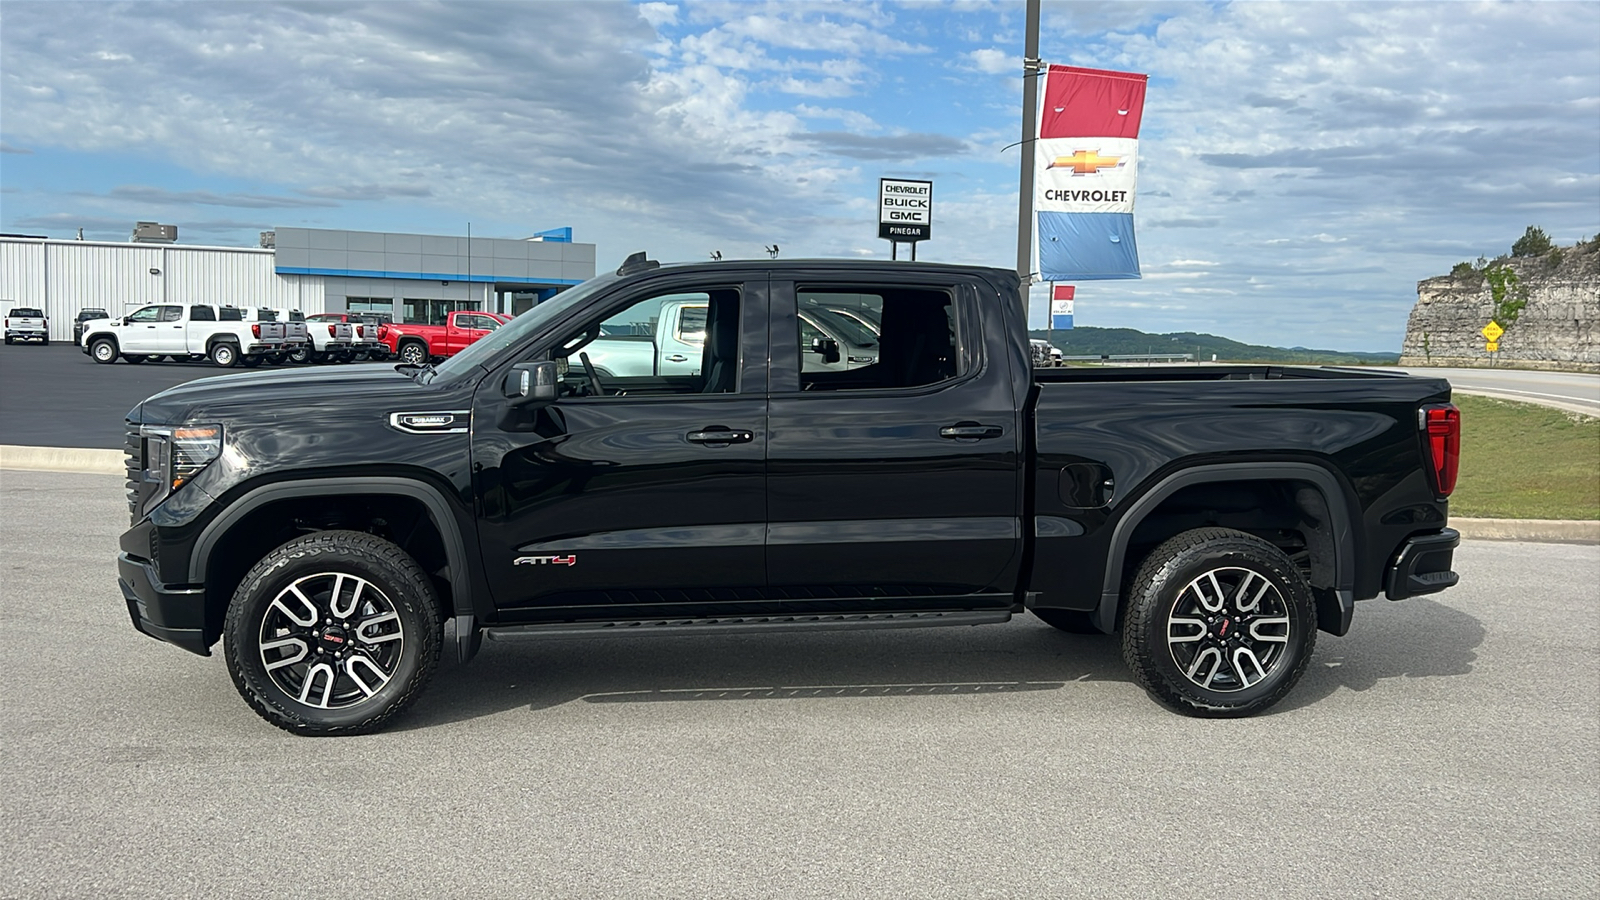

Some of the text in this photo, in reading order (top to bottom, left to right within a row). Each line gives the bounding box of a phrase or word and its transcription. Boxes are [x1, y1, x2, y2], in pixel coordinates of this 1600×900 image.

[885, 185, 928, 195] CHEVROLET
[884, 198, 928, 208] BUICK
[890, 211, 922, 221] GMC
[889, 227, 921, 235] PINEGAR
[513, 554, 576, 567] AT4
